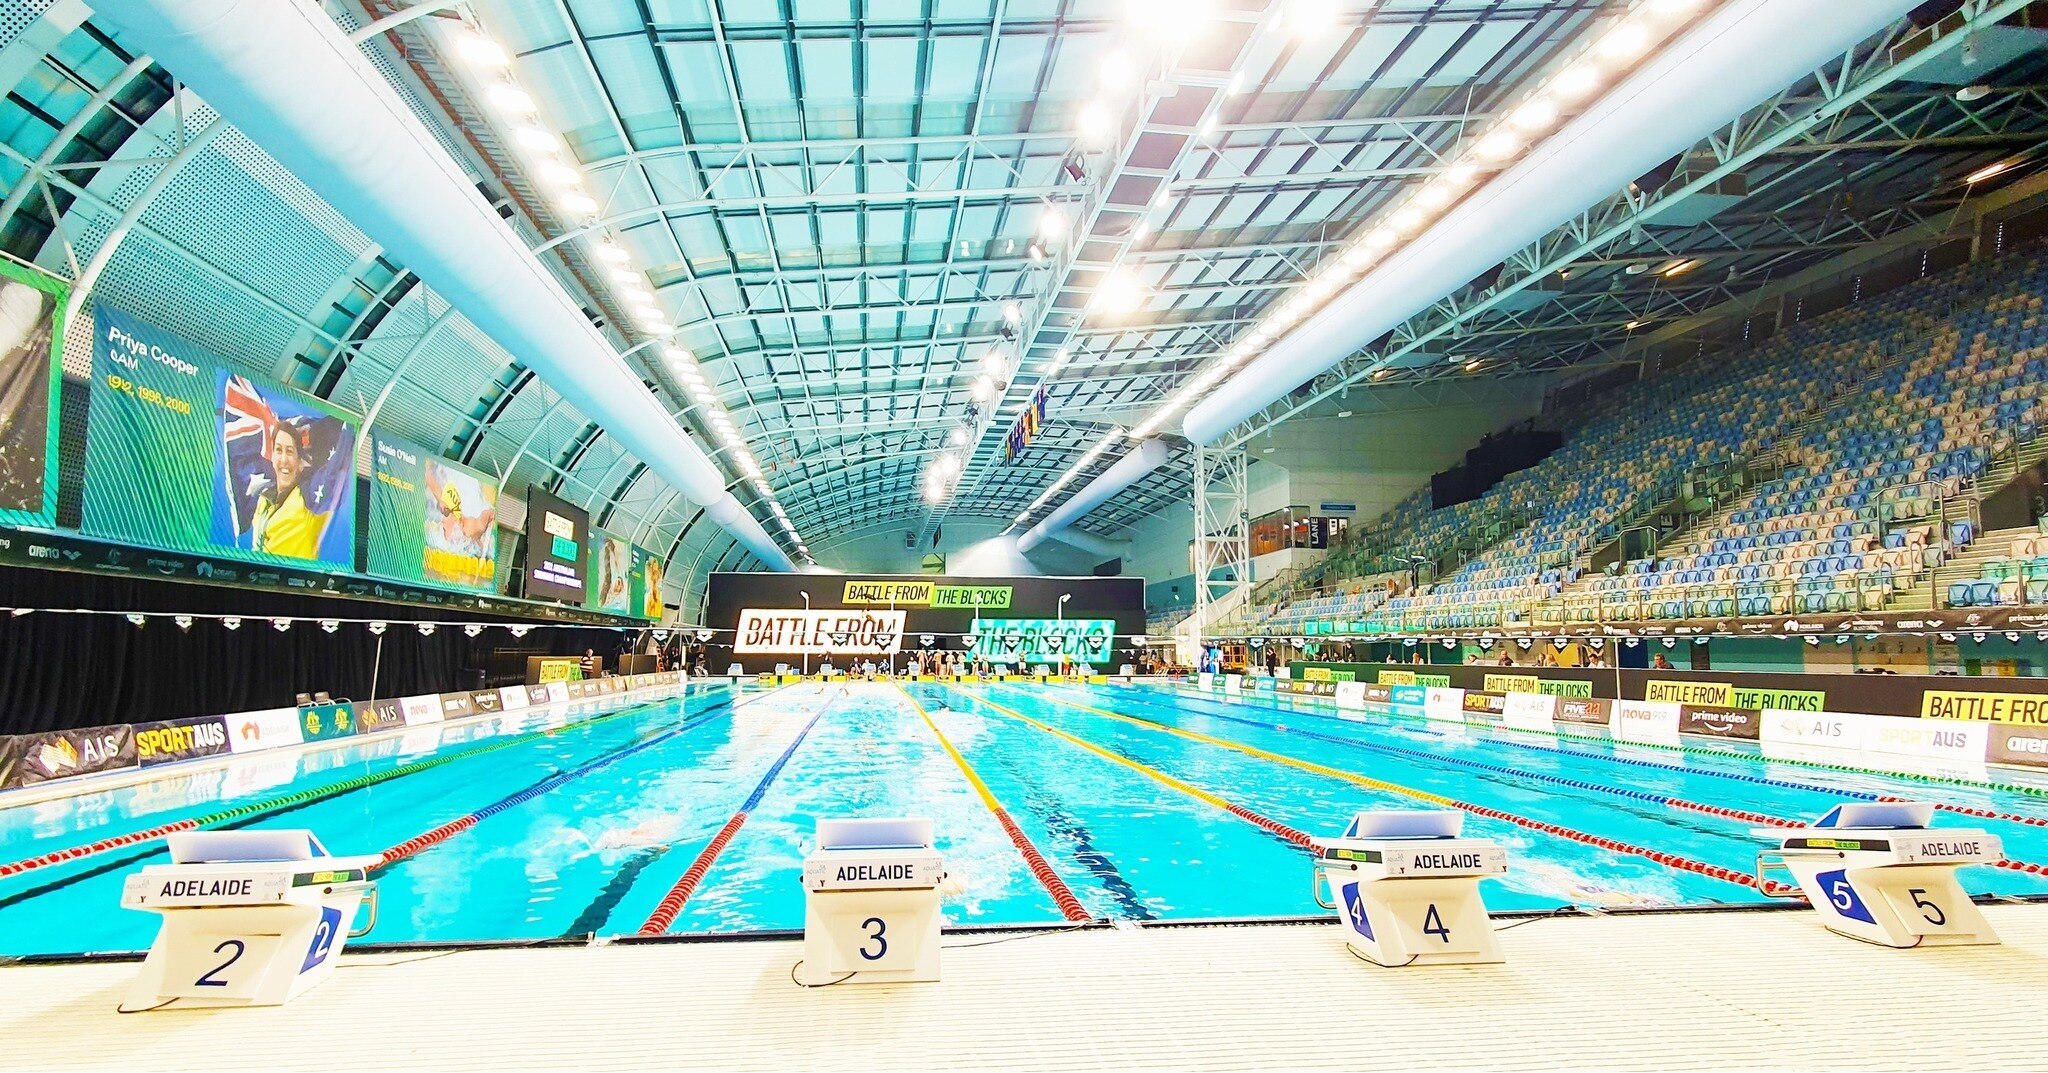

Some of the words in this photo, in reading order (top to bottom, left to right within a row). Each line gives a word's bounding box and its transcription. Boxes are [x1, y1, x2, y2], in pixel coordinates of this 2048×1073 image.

[108, 326, 148, 356] Priya
[150, 345, 199, 377] Cooper
[165, 396, 190, 415] 2000
[1311, 517, 1319, 544] LANE
[28, 544, 60, 559] arena
[848, 585, 893, 600] BATTLE
[894, 585, 930, 601] FROM
[937, 589, 959, 604] THE
[960, 590, 1007, 605] BLOCKS
[745, 617, 829, 646] BATTLE
[1380, 672, 1397, 684] BATTLE
[1398, 674, 1414, 685] FROM
[1486, 677, 1512, 692] BATTLE
[1513, 679, 1535, 693] FROM
[1539, 683, 1555, 695] THE
[1556, 684, 1589, 698] BLOCKS
[1650, 684, 1690, 703] BATTLE
[1692, 687, 1726, 704] FROM
[1465, 693, 1505, 708] SPORTAUS
[1735, 692, 1759, 709] THE
[1761, 694, 1818, 712] BLOCKS
[1929, 696, 2004, 721] BATTLE
[379, 705, 398, 722] AIS
[1691, 710, 1719, 722] prime
[1720, 712, 1748, 724] video
[1812, 721, 1843, 737] AIS
[83, 735, 120, 763] AIS
[135, 722, 226, 757] SPORTAUS
[1921, 842, 1981, 857] ADELAIDE
[1414, 854, 1482, 869] ADELAIDE
[836, 864, 914, 881] ADELAIDE
[160, 879, 253, 897] ADELAIDE
[1832, 880, 1852, 910] 5
[1350, 896, 1363, 926] 4
[1908, 888, 1946, 926] 5
[1423, 903, 1450, 943] 4
[314, 920, 330, 959] 2
[859, 917, 888, 961] 3
[194, 939, 245, 987] 2
